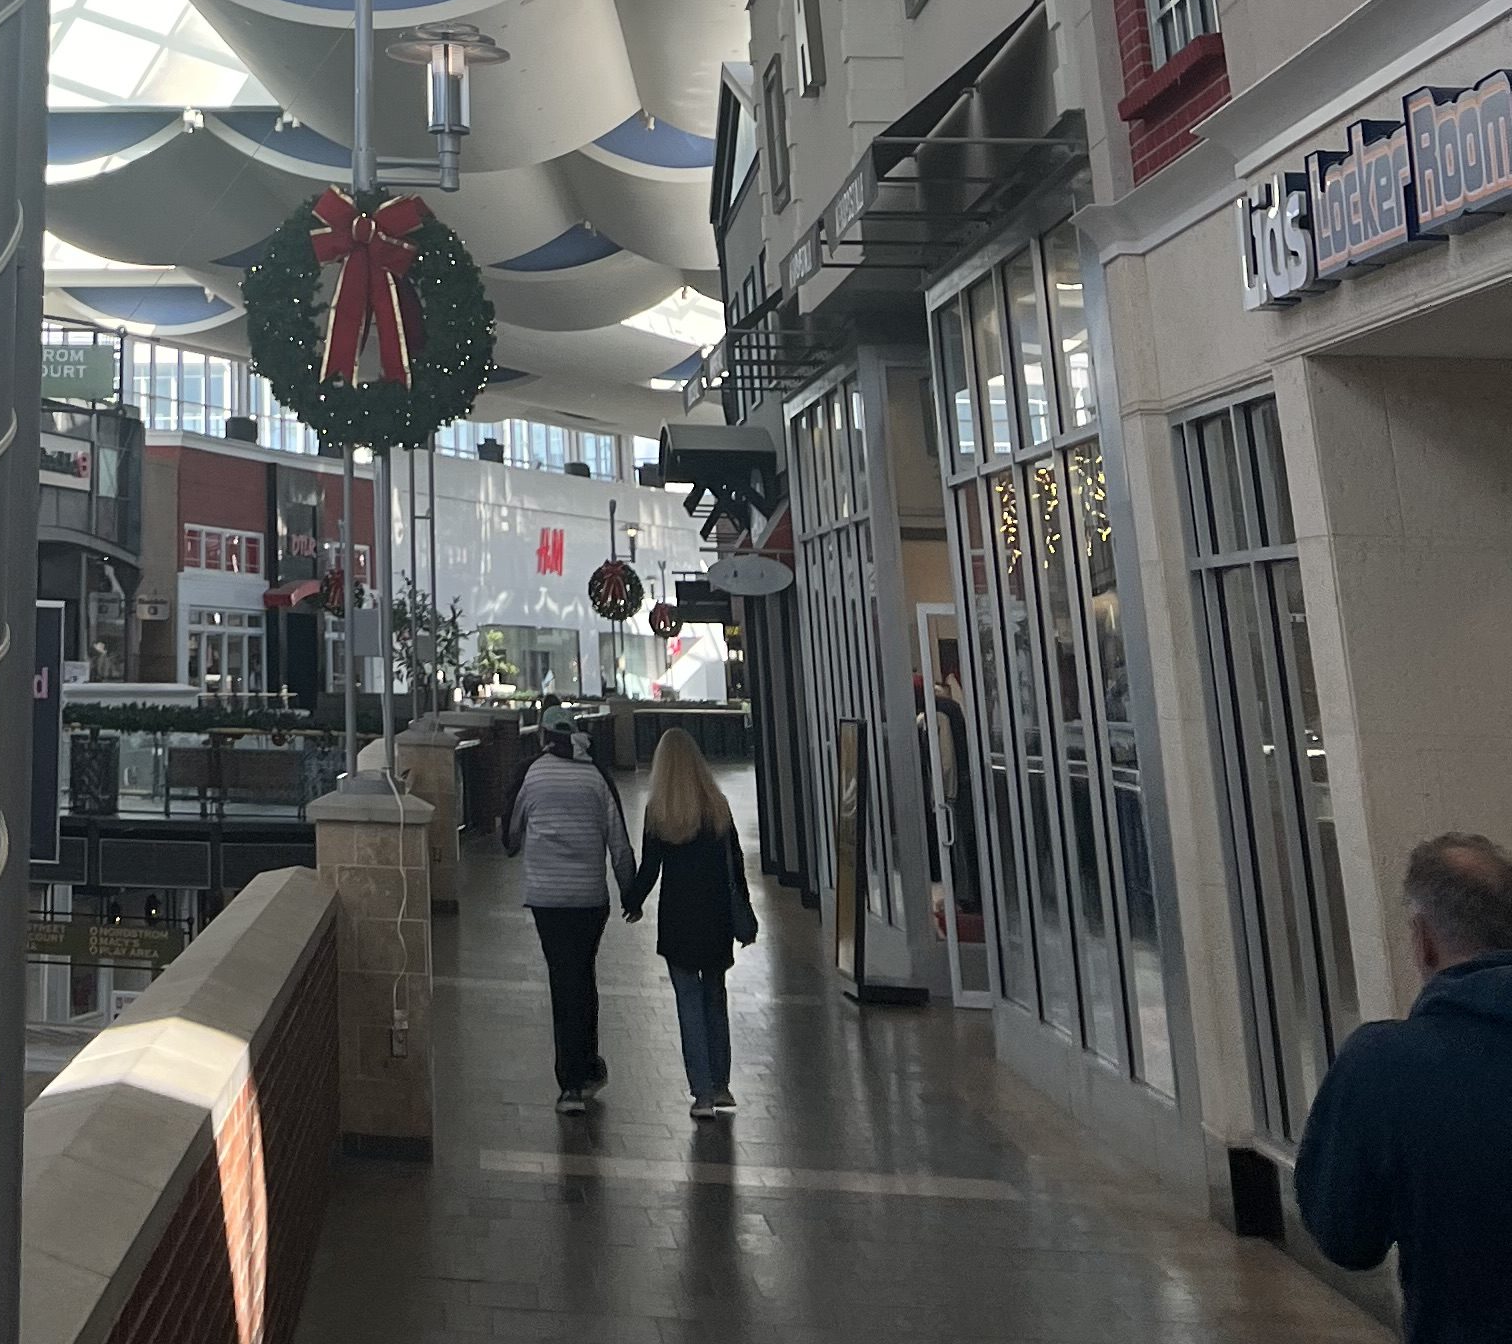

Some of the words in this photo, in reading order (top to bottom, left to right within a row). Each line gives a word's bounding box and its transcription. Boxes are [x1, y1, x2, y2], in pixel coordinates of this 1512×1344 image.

[1306, 121, 1408, 277] Locker
[1404, 70, 1512, 232] Room
[99, 928, 169, 940] NORDSTROM
